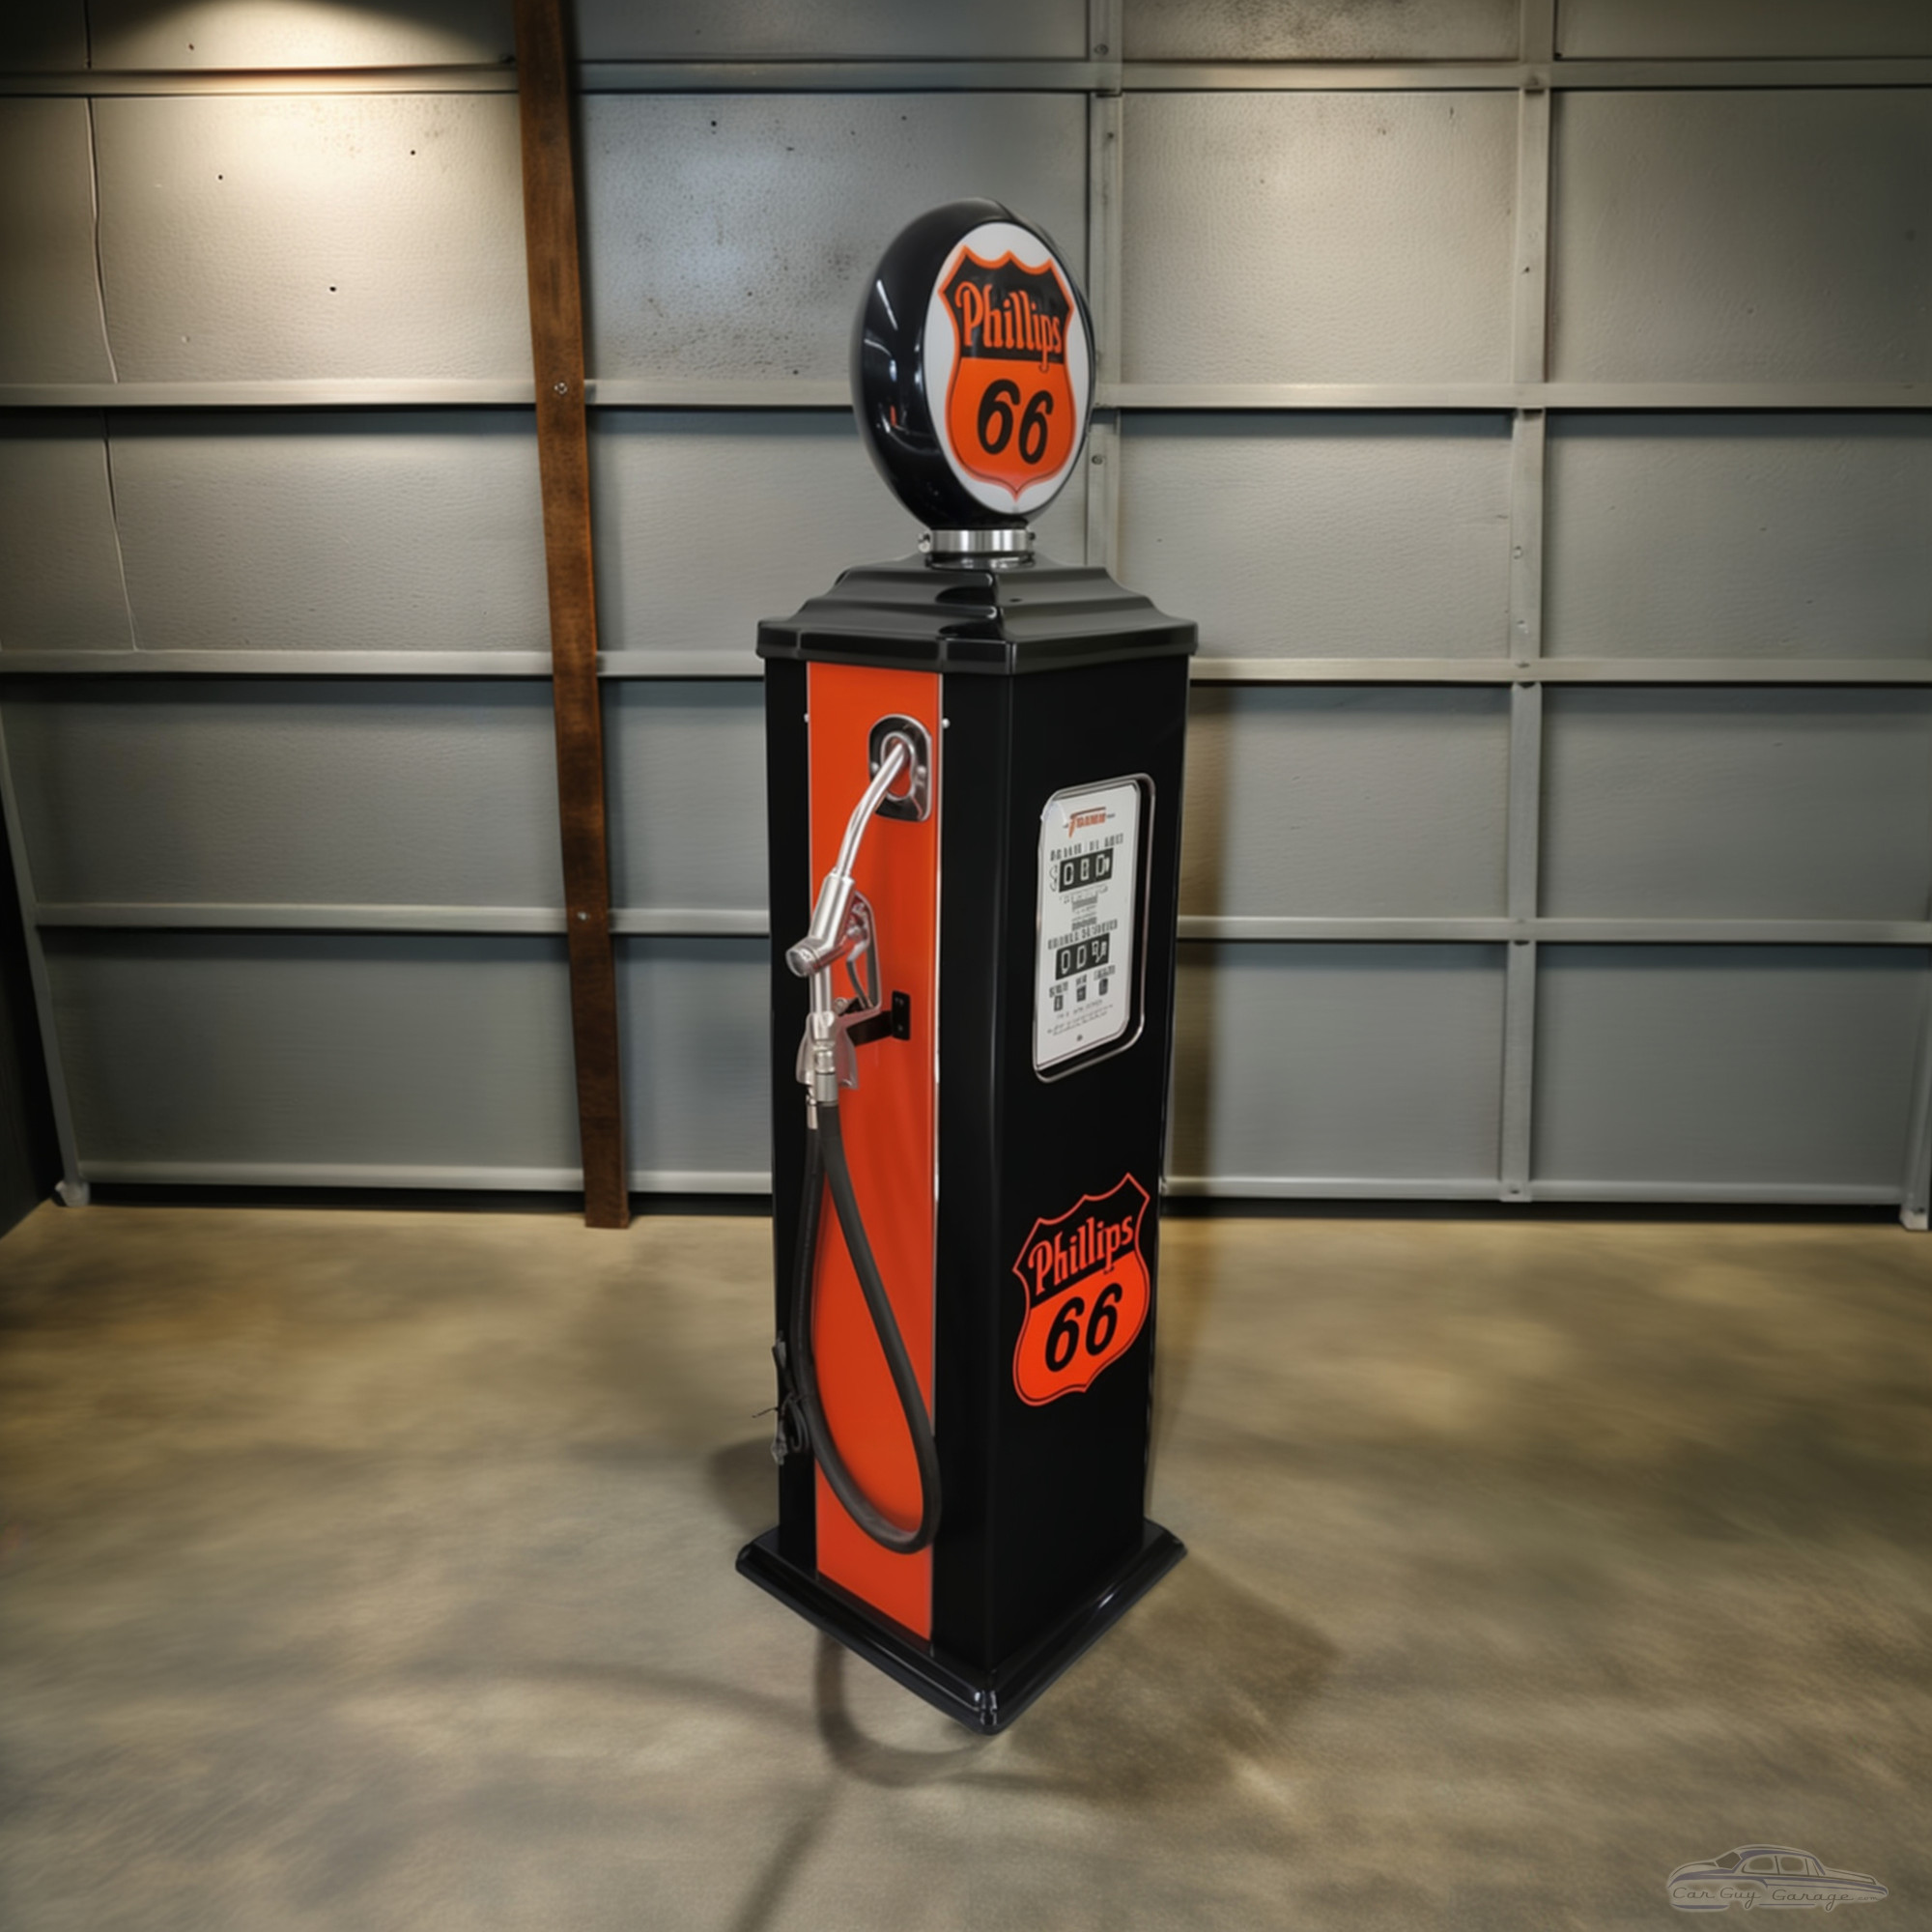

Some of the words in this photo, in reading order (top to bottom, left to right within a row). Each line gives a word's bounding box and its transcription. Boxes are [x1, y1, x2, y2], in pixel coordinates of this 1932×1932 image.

[954, 281, 1063, 373] Phillips
[977, 379, 1054, 465] 66
[1028, 1215, 1134, 1296] Phillips
[1044, 1282, 1123, 1373] 66
